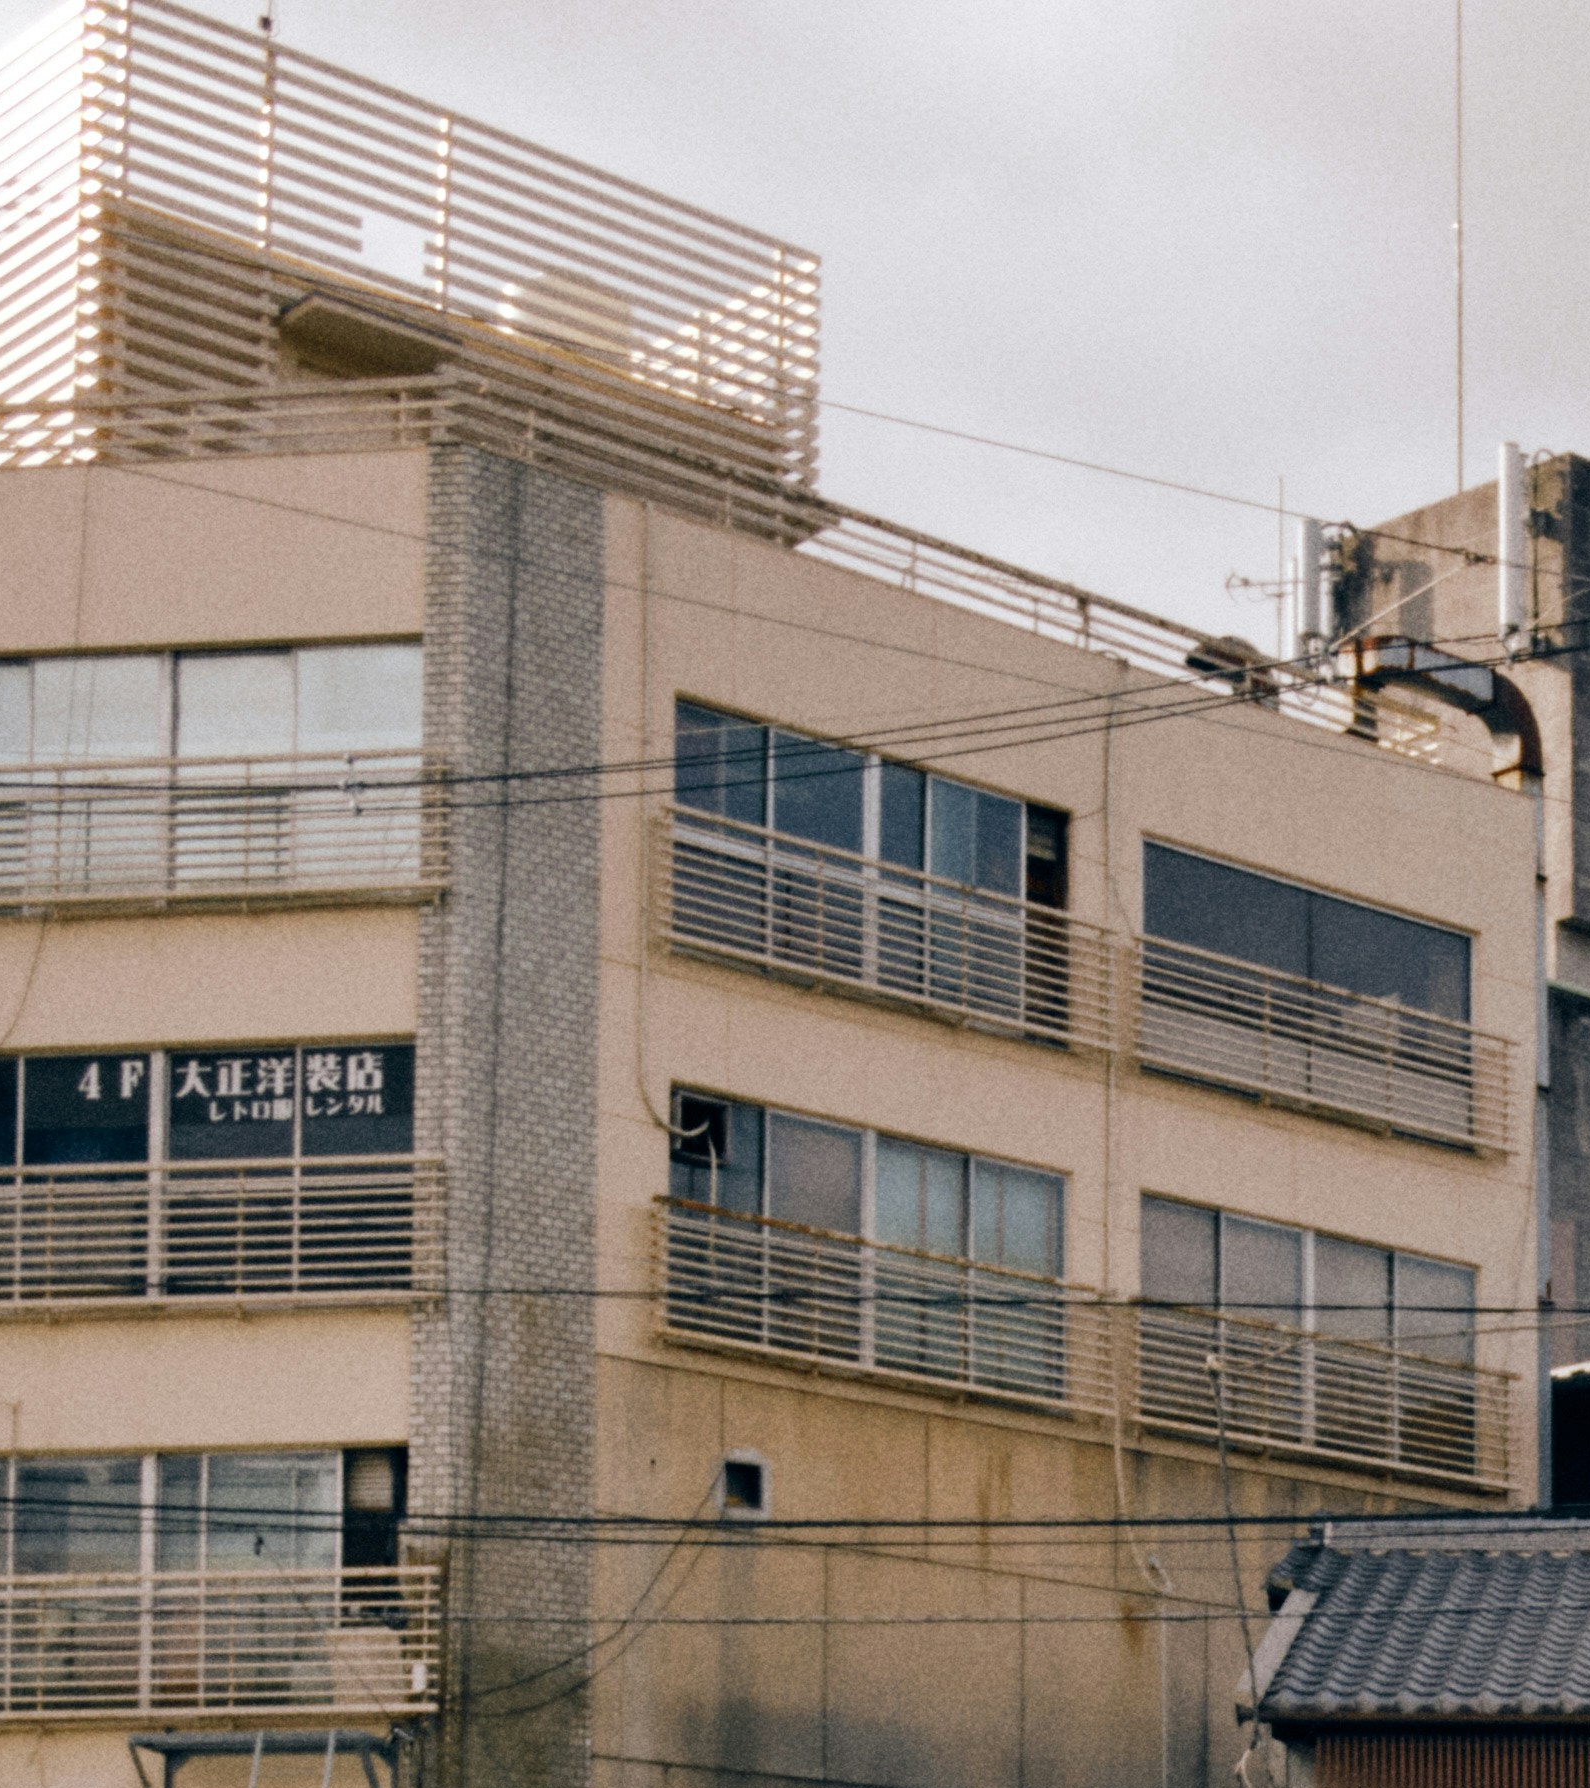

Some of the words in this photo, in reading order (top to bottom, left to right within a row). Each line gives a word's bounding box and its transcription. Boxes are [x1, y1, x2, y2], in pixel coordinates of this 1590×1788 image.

[176, 1052, 384, 1099] 大正洋装店
